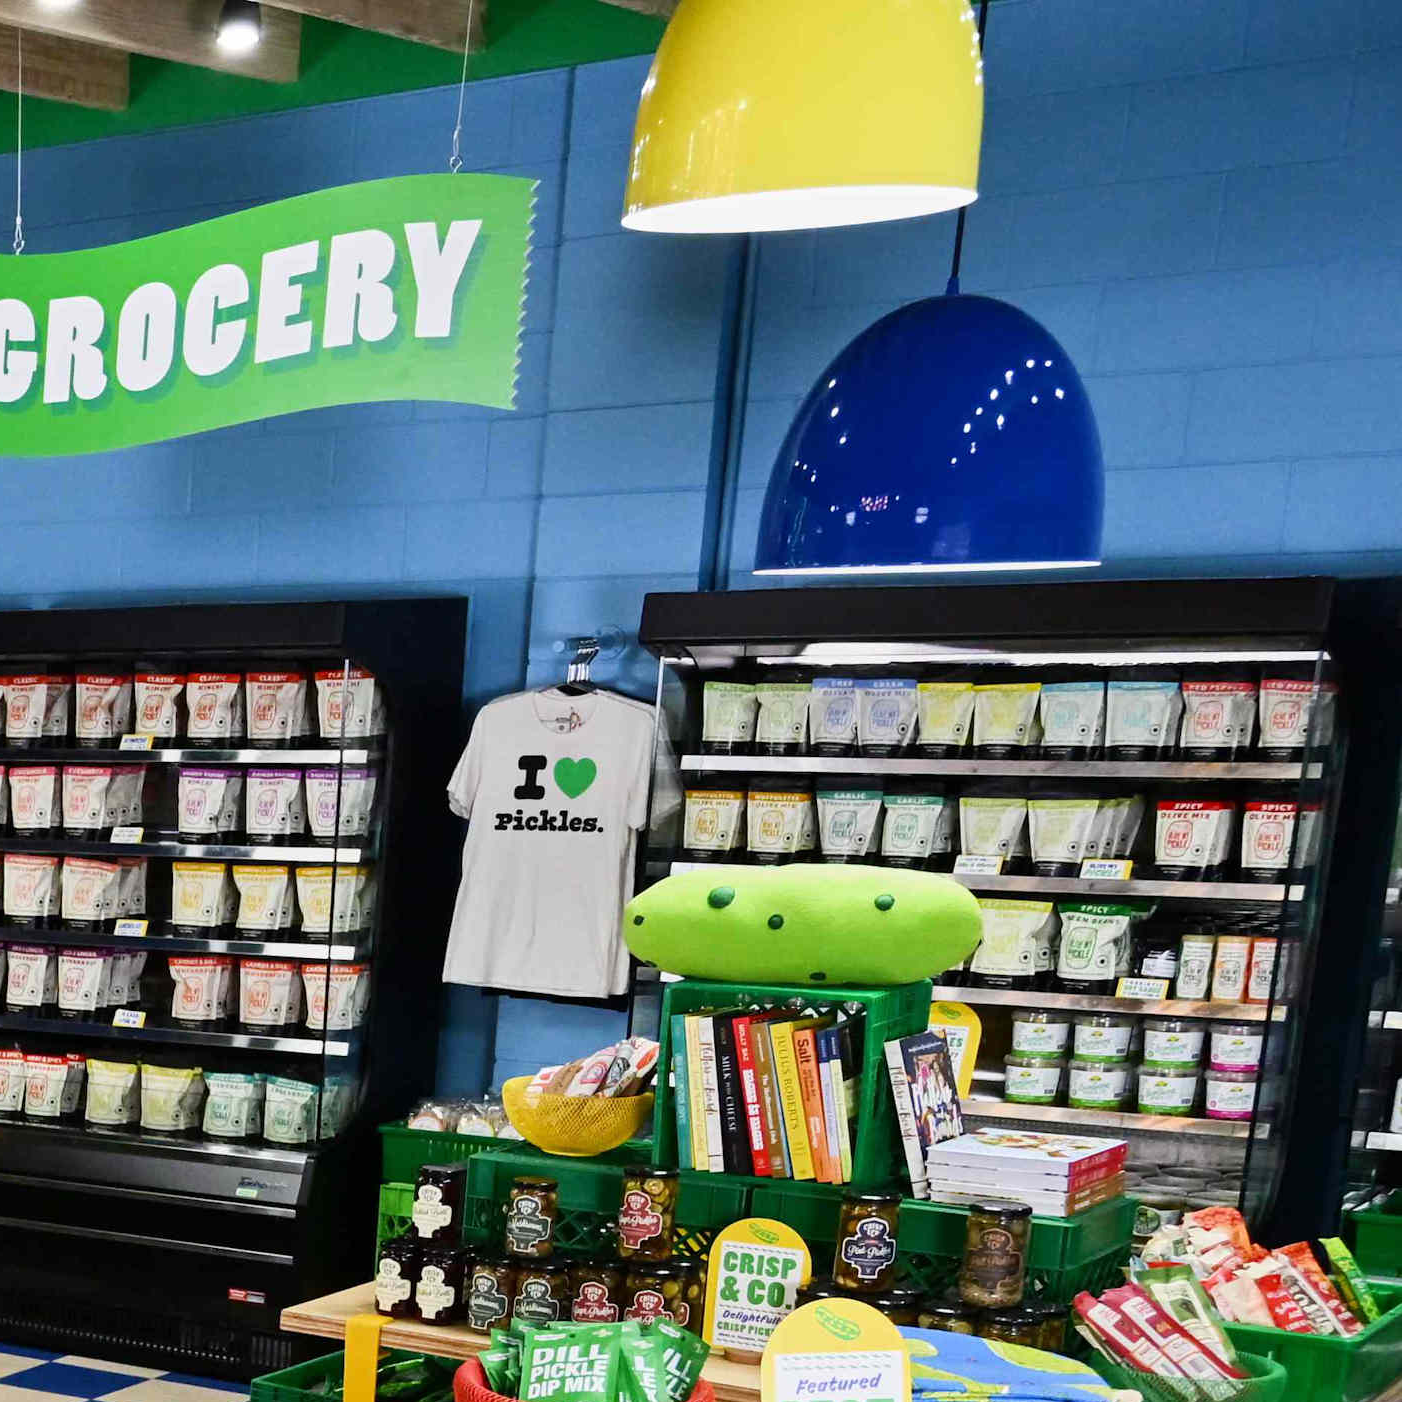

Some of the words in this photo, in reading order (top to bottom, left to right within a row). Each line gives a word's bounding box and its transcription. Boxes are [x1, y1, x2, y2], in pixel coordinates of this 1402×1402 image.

[513, 754, 547, 800] I
[1173, 802, 1204, 810] SPICY
[494, 809, 605, 834] Pickles.
[797, 1038, 812, 1064] Salt
[721, 1055, 732, 1084] MILK
[722, 1250, 797, 1280] CRISP
[720, 1275, 740, 1302] &
[746, 1278, 793, 1310] CO.
[716, 1320, 748, 1333] CRISP
[532, 1343, 609, 1366] DILL
[530, 1360, 608, 1383] PICKLE
[527, 1381, 561, 1400] DIP
[564, 1376, 606, 1394] MIX
[795, 1373, 882, 1396] Featured
